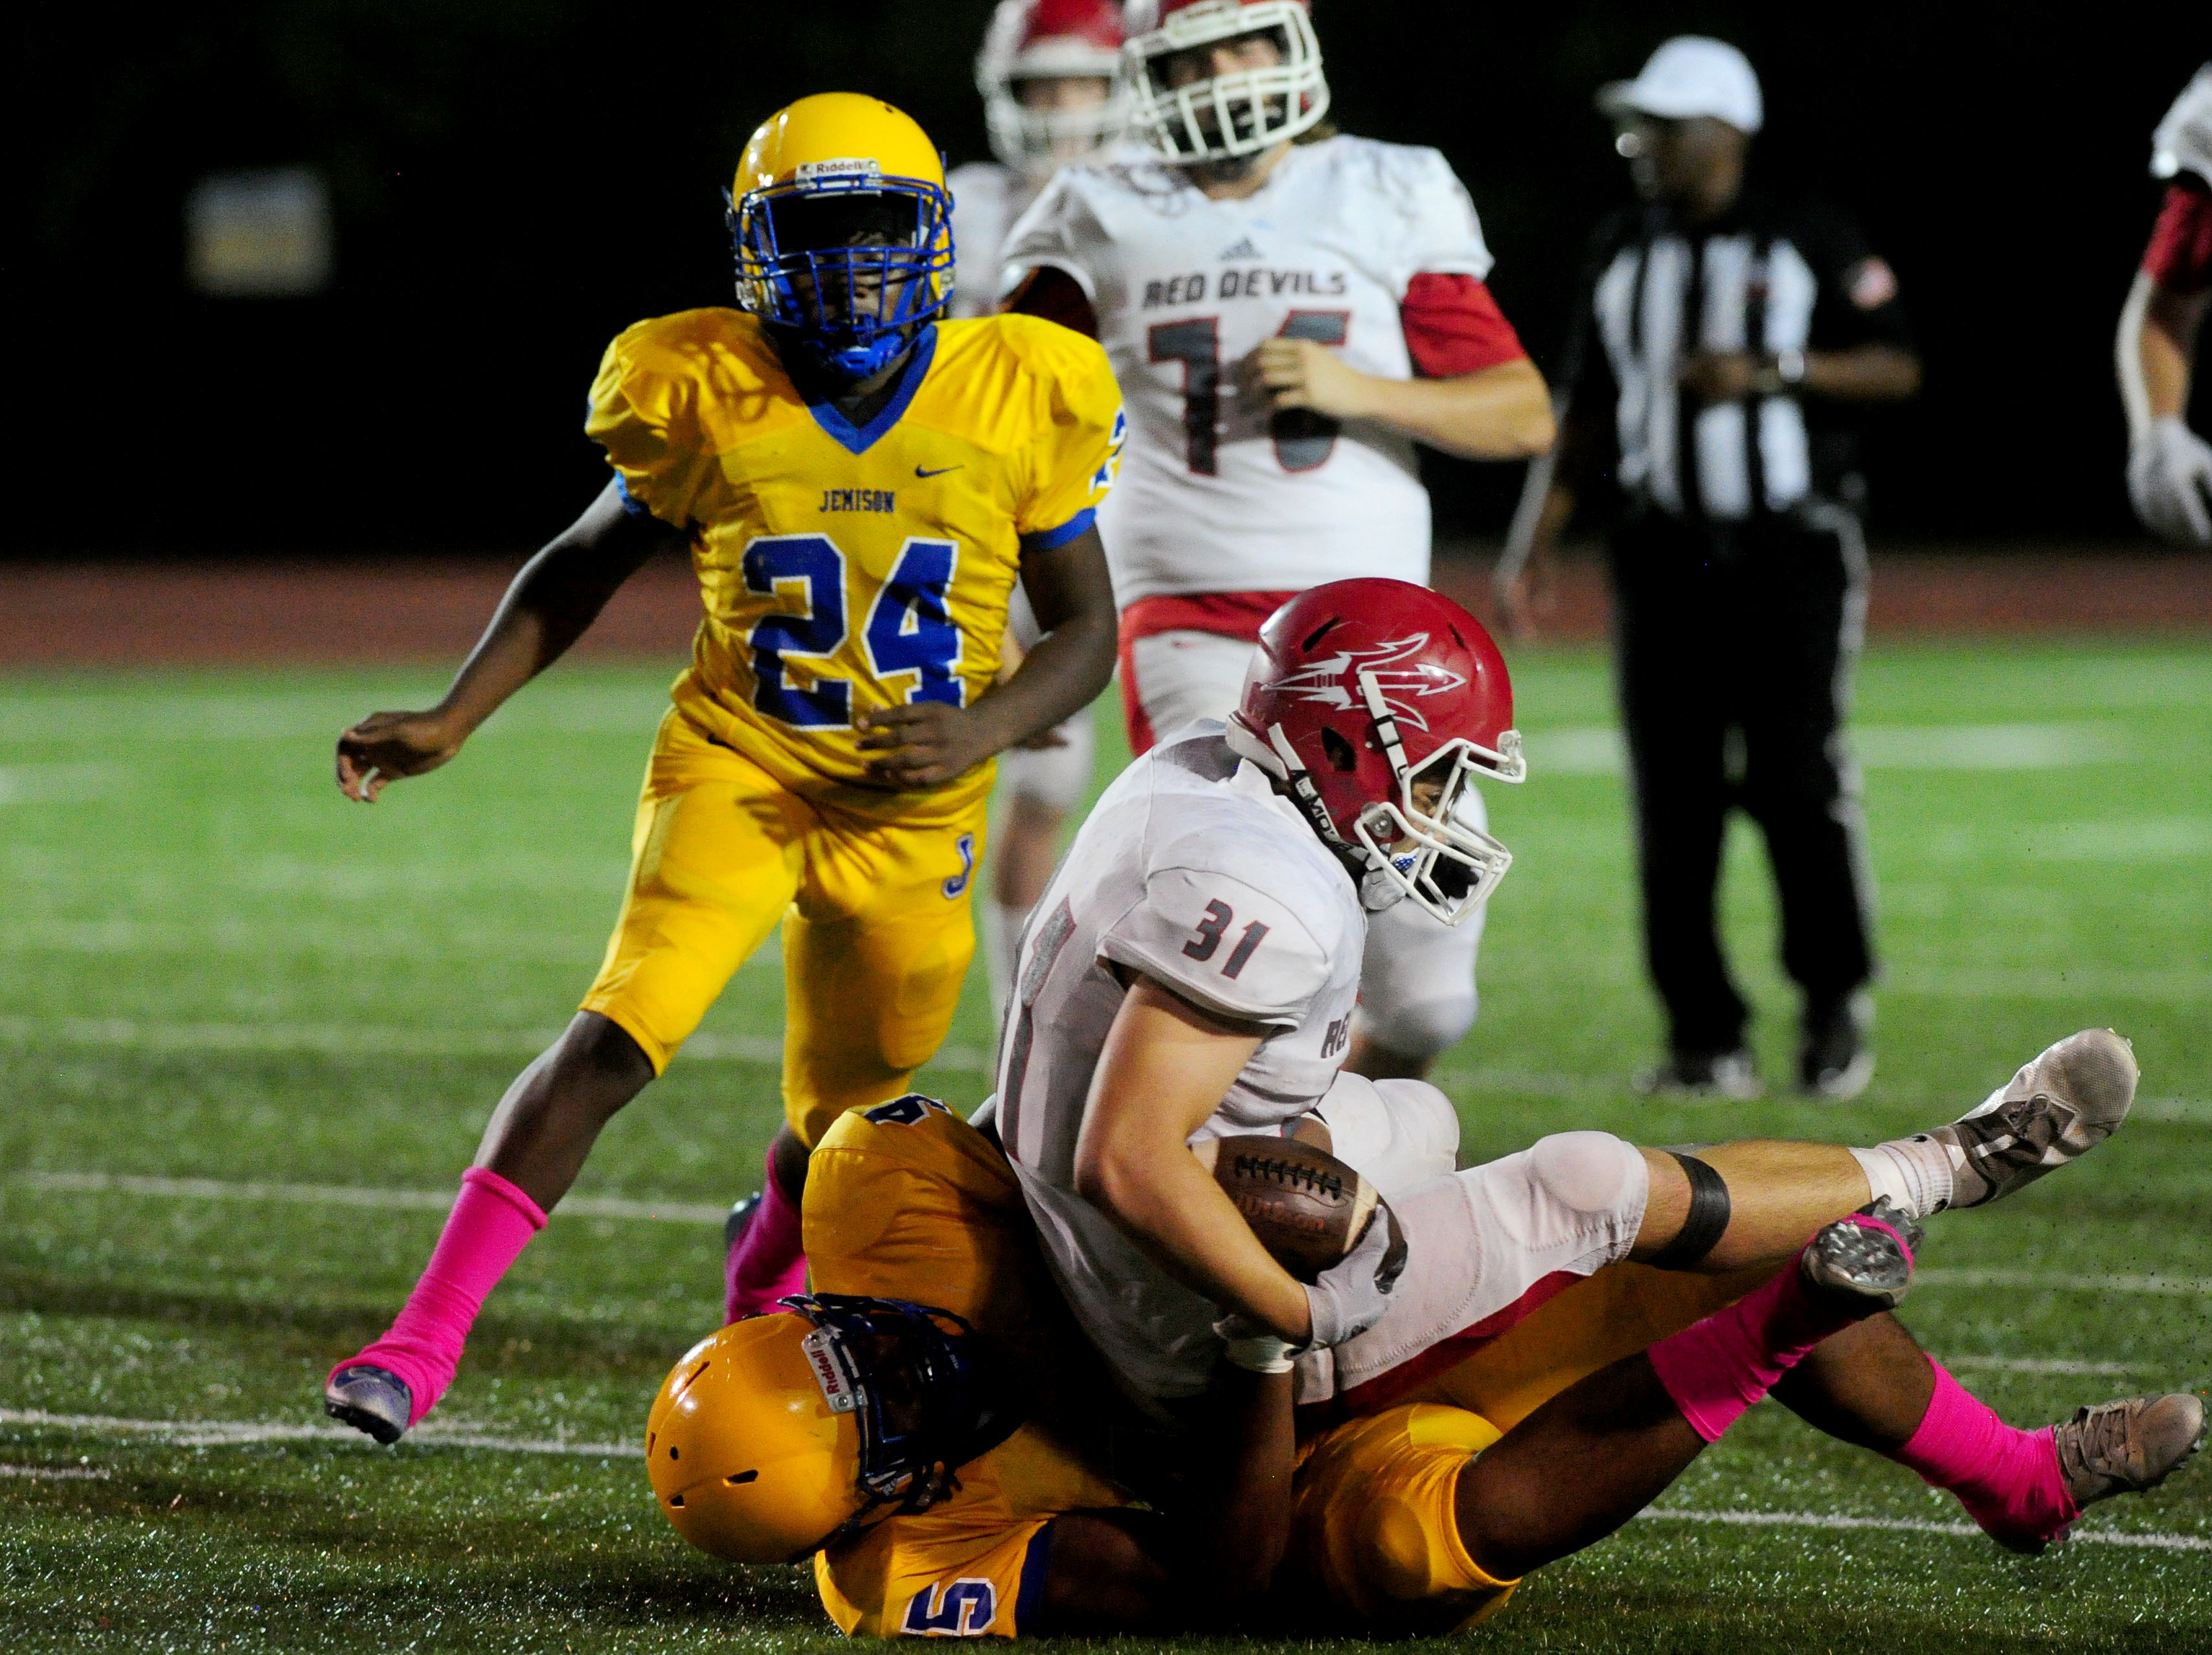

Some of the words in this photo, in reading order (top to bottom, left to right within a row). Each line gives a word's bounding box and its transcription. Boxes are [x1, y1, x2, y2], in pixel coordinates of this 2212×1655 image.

[817, 161, 862, 173] Riddell
[1142, 273, 1207, 310] RED
[1218, 268, 1347, 298] DEVILS
[818, 488, 895, 513] JEMISON
[741, 532, 966, 732] 24
[942, 832, 975, 900] J
[1181, 897, 1270, 980] 31
[811, 1349, 841, 1395] Riddell
